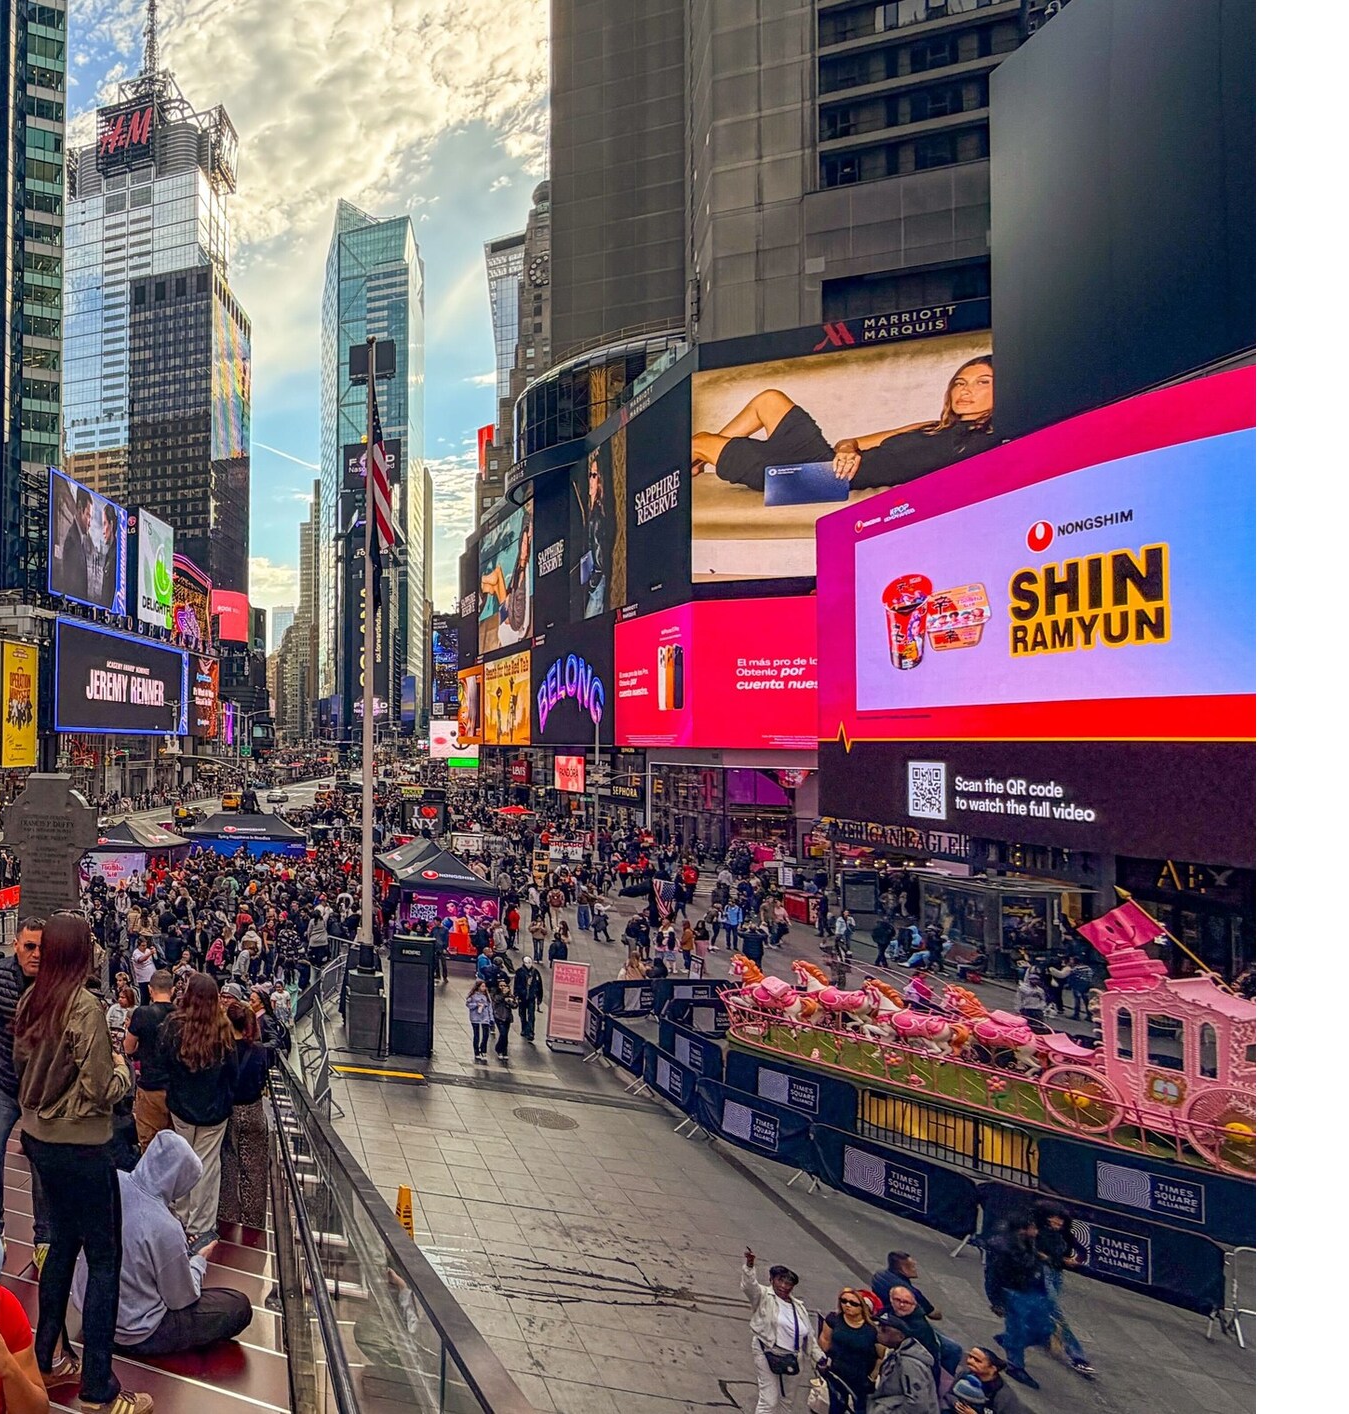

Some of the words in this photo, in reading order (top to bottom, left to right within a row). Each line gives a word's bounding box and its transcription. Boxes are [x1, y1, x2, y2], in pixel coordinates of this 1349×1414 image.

[100, 107, 153, 156] H&M
[863, 305, 957, 329] MARRIOTT
[863, 318, 946, 341] MARQUIS
[634, 470, 680, 511] SAPPHIRE
[636, 490, 678, 526] RESERVE
[1057, 509, 1134, 538] NONGSHIM
[1011, 546, 1164, 621] SHIN
[1011, 605, 1166, 654] RAMYUN
[737, 659, 747, 667] El
[749, 657, 770, 667] más
[773, 659, 791, 669] pro
[792, 657, 807, 666] de
[780, 666, 806, 678] por
[86, 668, 129, 703] JEREMY
[130, 676, 165, 707] RENNER
[736, 679, 785, 690] cuenta
[537, 653, 605, 735] BELONG
[612, 785, 638, 798] SEPHORA
[954, 776, 981, 793] Scan
[984, 778, 1003, 794] the
[1006, 779, 1027, 797] QR
[1029, 782, 1063, 799] code
[413, 806, 420, 818] I
[955, 796, 967, 811] to
[969, 797, 1004, 815] watch
[1006, 799, 1027, 815] the
[1029, 801, 1050, 818] full
[1052, 803, 1096, 823] video
[410, 818, 439, 830] NY
[905, 828, 960, 856] EAGLE
[790, 1088, 816, 1102] SQUARE
[792, 1083, 814, 1096] TIMES
[753, 1124, 776, 1139] SQUARE
[754, 1117, 775, 1130] TIMES
[891, 1170, 920, 1187] TIMES
[888, 1179, 923, 1197] SQUARE
[889, 1187, 921, 1203] ALLIANCE
[1158, 1182, 1195, 1198] TIMES
[1154, 1190, 1198, 1207] SQUARE
[1157, 1199, 1196, 1214] ALLIANCE
[1099, 1236, 1140, 1254] TIMES
[1094, 1244, 1144, 1265] SQUARE
[1098, 1255, 1142, 1273] ALLIANCE
